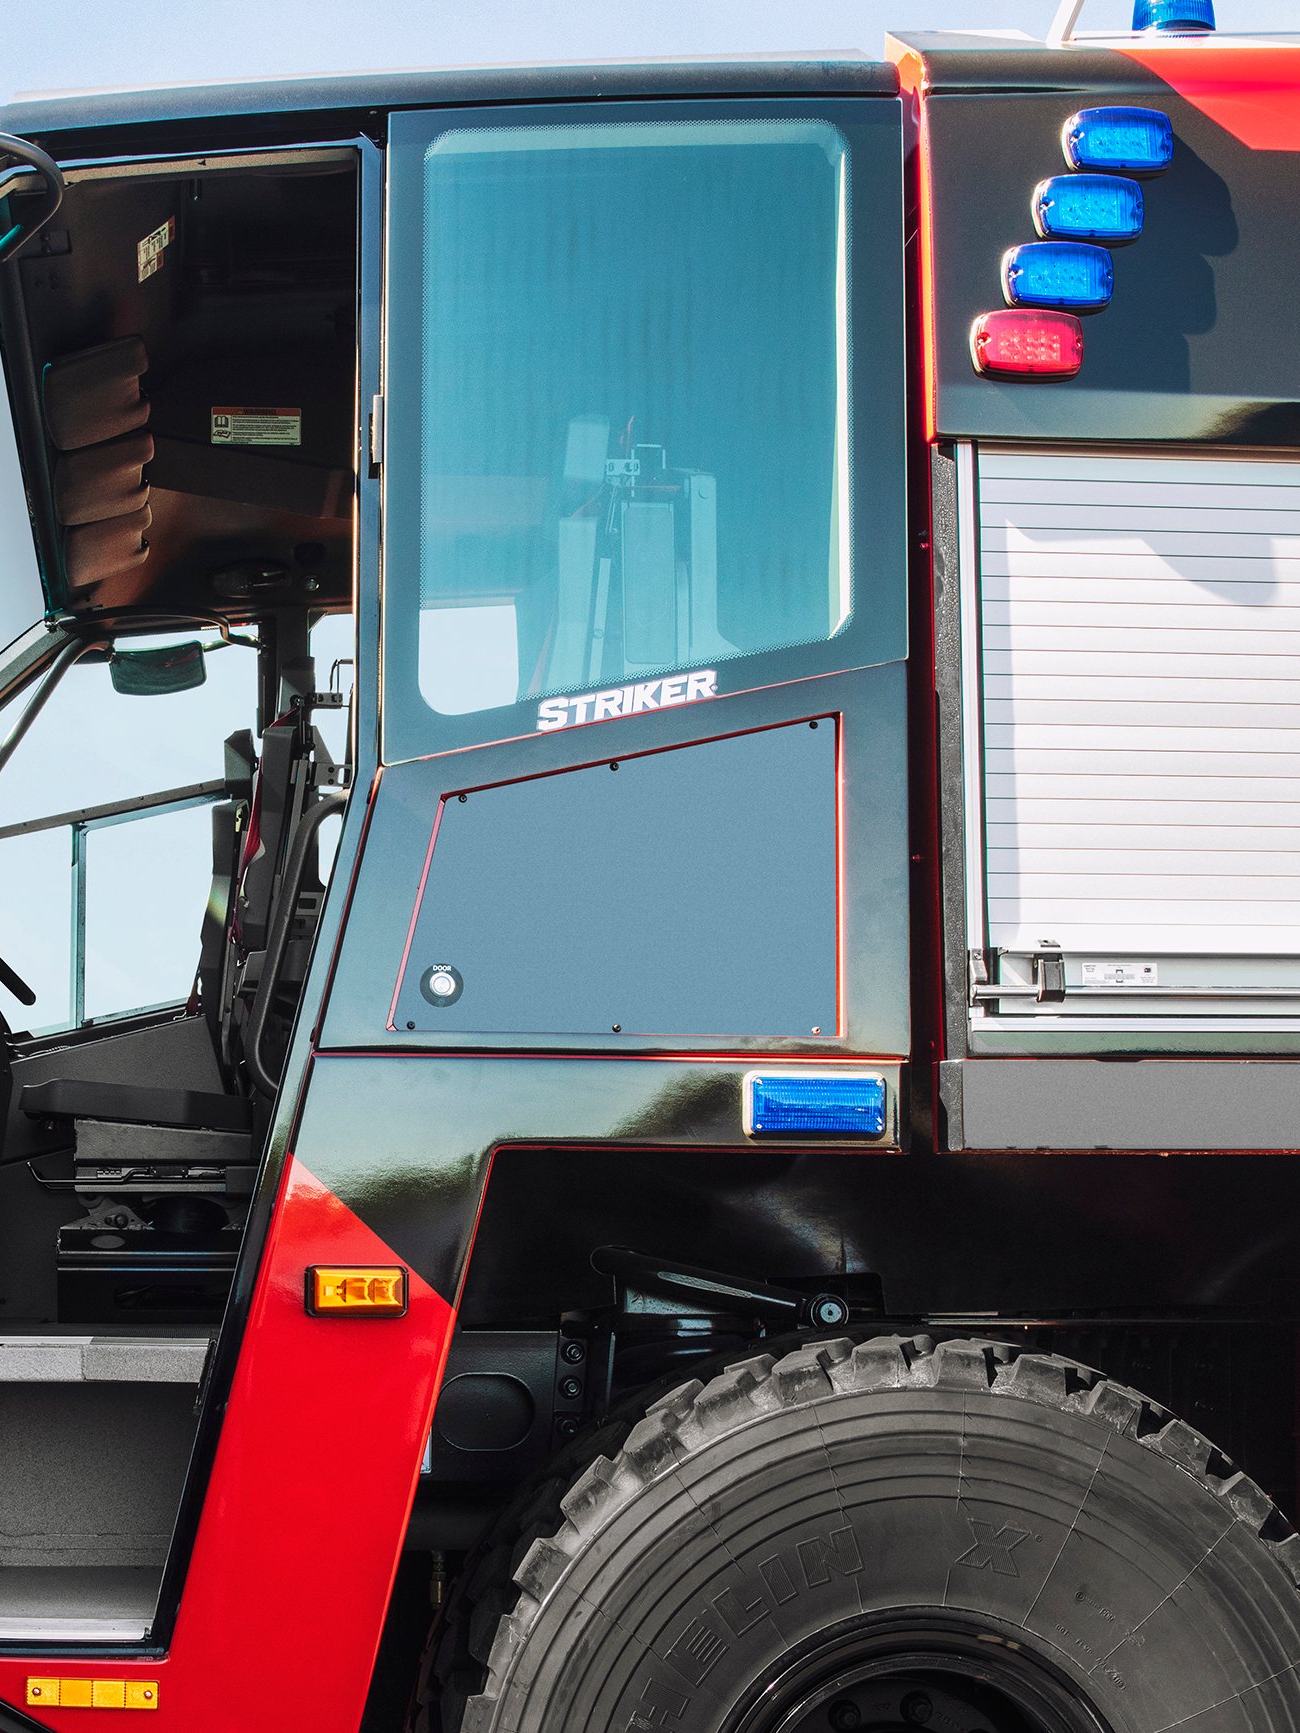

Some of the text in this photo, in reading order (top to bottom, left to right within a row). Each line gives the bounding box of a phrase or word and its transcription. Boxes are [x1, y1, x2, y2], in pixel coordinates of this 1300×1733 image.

[537, 670, 717, 731] STRIKER
[432, 964, 452, 972] DOOR
[954, 1516, 1033, 1579] X
